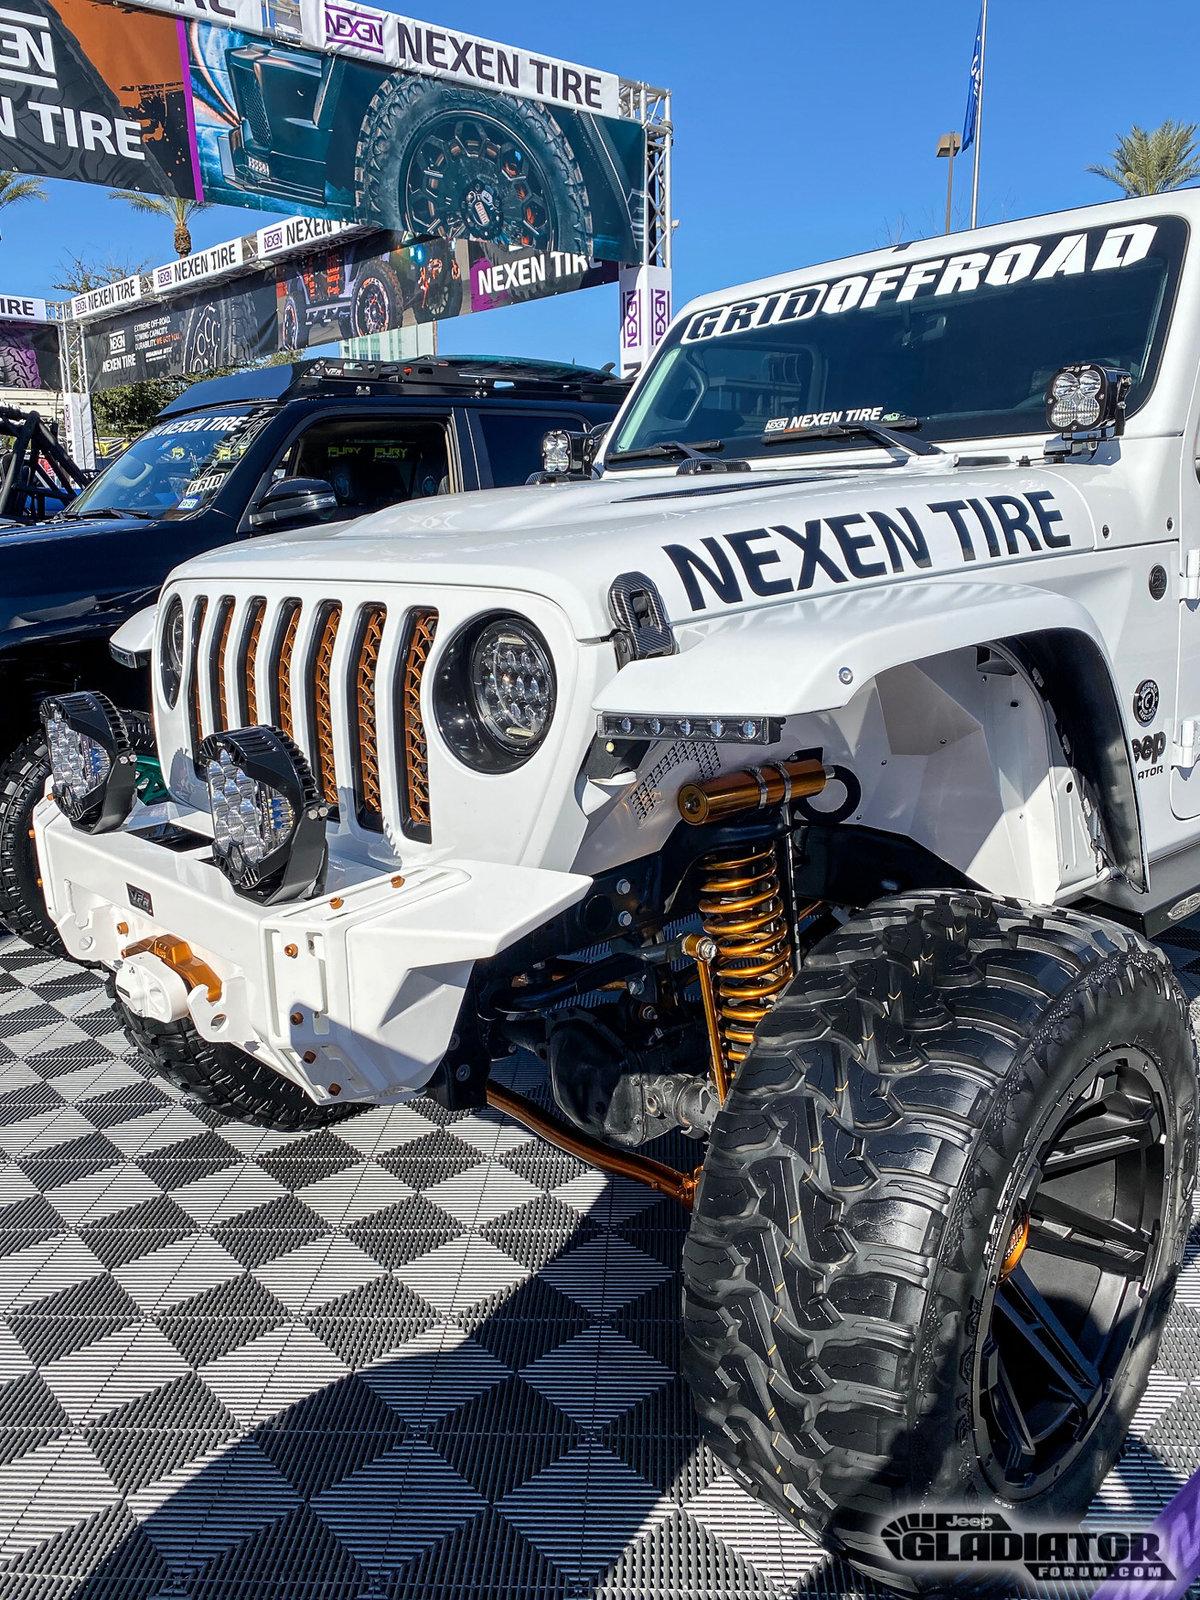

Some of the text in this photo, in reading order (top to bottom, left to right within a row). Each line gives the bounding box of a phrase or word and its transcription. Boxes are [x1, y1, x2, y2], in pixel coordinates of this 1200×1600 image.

[326, 11, 383, 46] NEXEN
[398, 22, 520, 89] NEXEN
[529, 58, 603, 109] TIRE
[27, 101, 145, 160] TIRE
[174, 256, 208, 282] NEXEN
[211, 244, 236, 269] TIRE
[478, 253, 546, 295] NEXEN
[88, 287, 114, 311] NEXEN
[115, 279, 136, 301] TIRE
[626, 289, 638, 348] NEXEN
[654, 289, 666, 346] NEXE
[102, 357, 122, 373] NEXEN
[122, 353, 137, 368] TIRE
[158, 418, 211, 437] NEXEN
[203, 416, 249, 432] TIRE
[789, 411, 843, 429] NEXEN
[846, 407, 883, 422] TIRE
[187, 473, 224, 496] GRID
[661, 490, 1072, 612] NEXEN TIRE
[1131, 731, 1167, 765] eep
